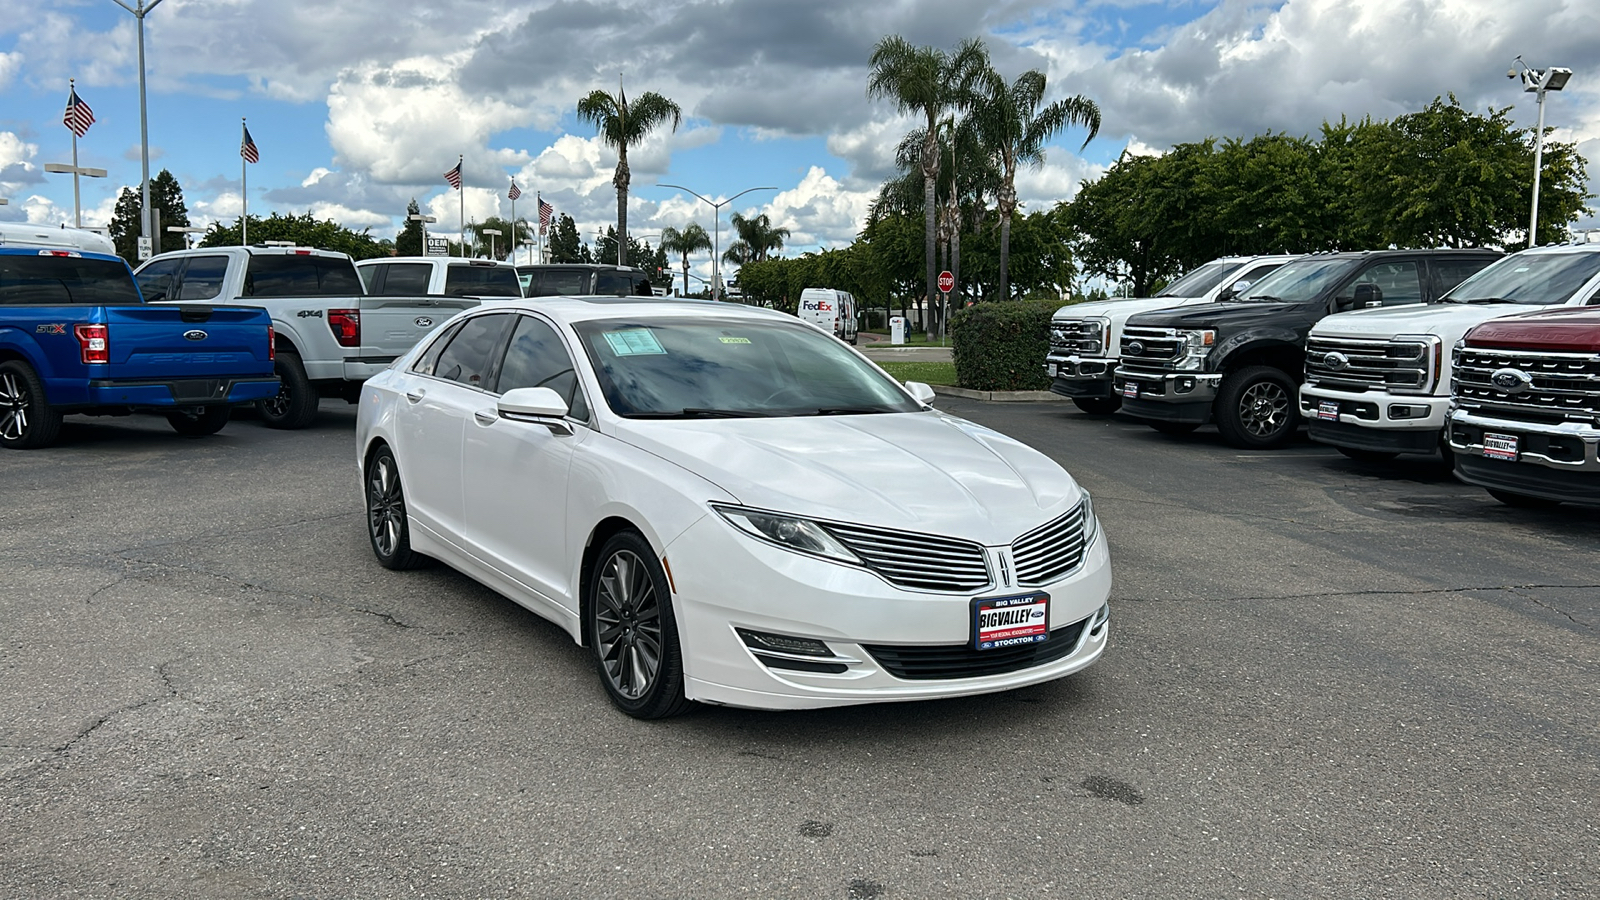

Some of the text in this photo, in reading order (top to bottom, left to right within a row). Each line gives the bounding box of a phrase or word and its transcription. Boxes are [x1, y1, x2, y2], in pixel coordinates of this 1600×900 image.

[939, 278, 952, 286] STOP
[803, 300, 832, 311] FedEx
[36, 323, 67, 335] STX
[1476, 330, 1585, 341] SUPER DUTY
[148, 354, 238, 364] F-150
[1497, 374, 1517, 386] Ford
[1486, 440, 1510, 450] BIGVALLEY
[980, 608, 1032, 628] BIGVALLEY
[994, 636, 1033, 647] STOCKTON
